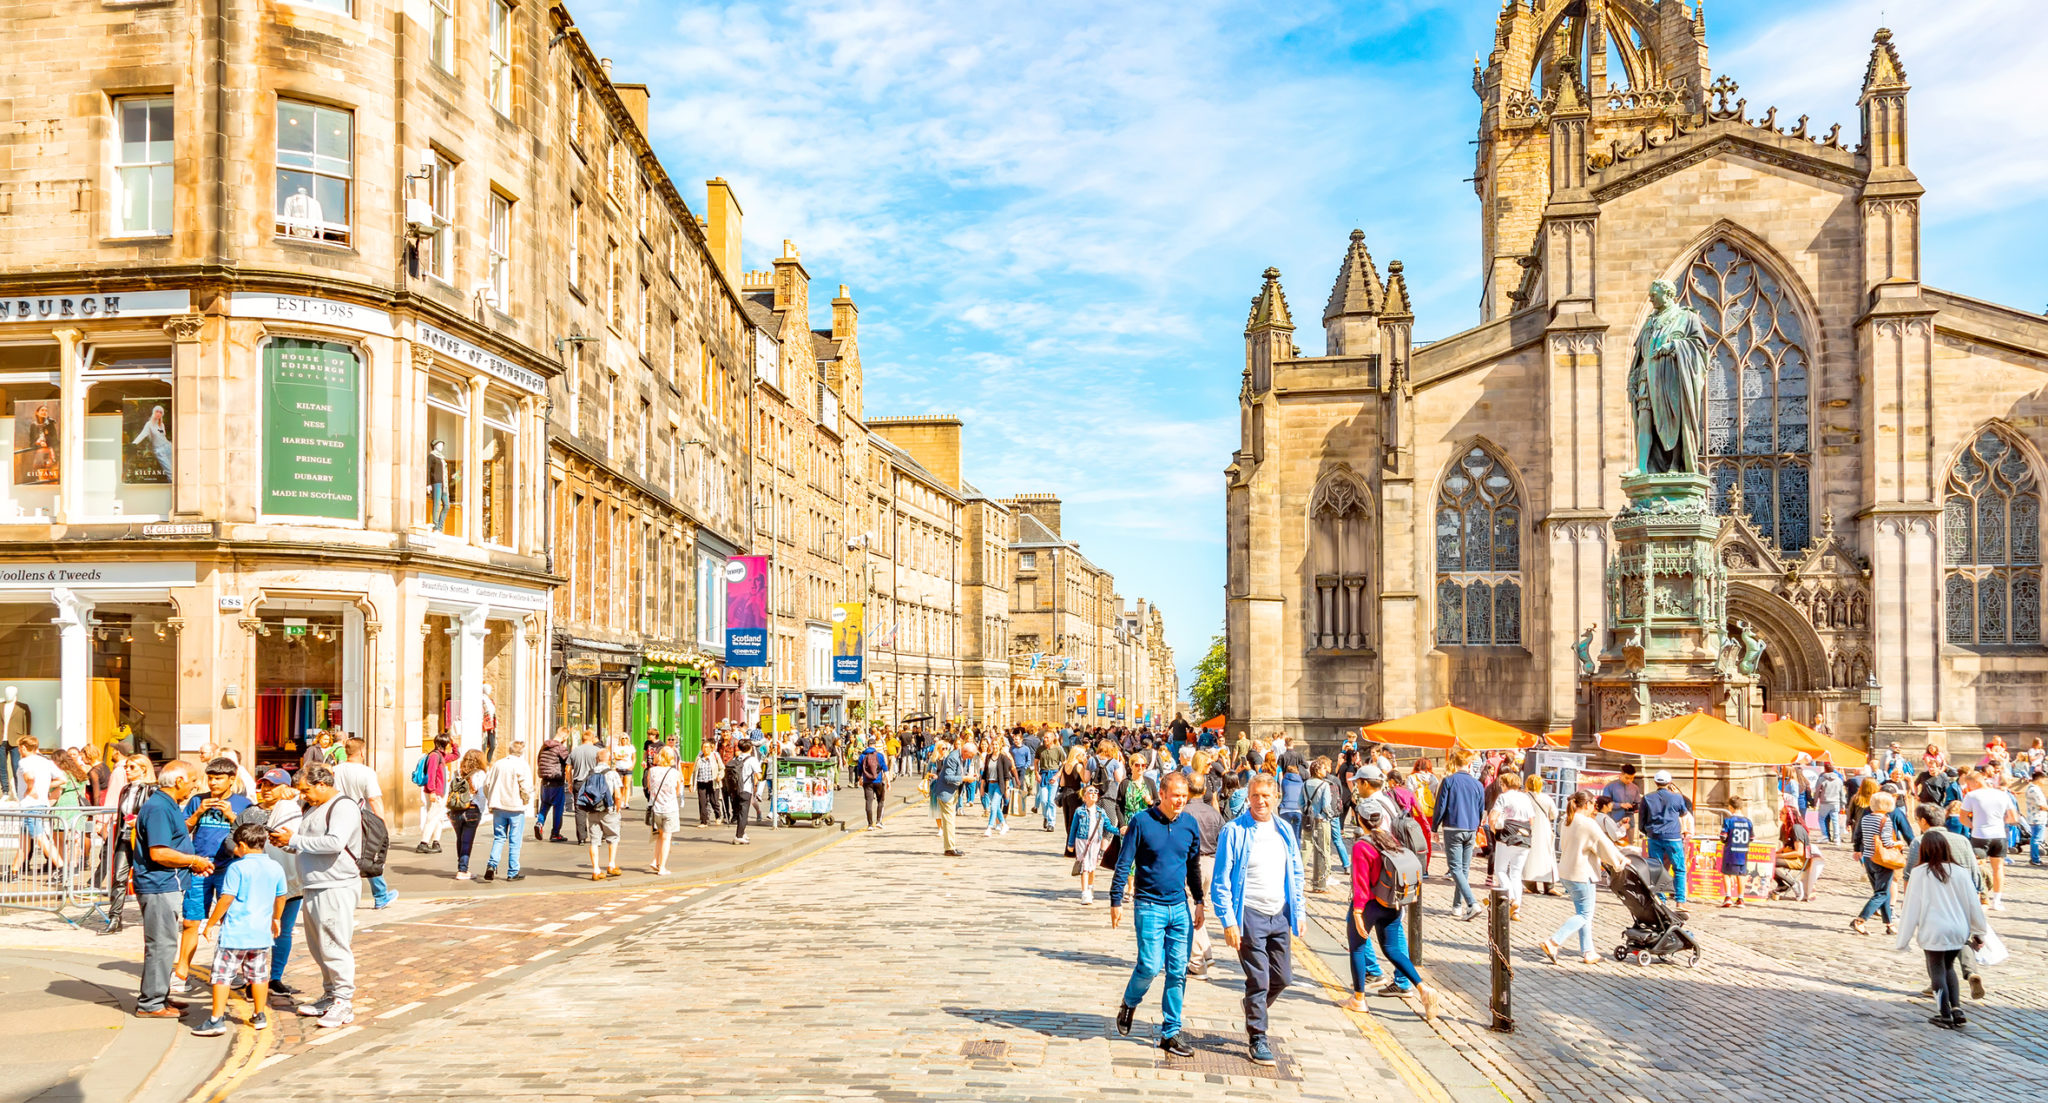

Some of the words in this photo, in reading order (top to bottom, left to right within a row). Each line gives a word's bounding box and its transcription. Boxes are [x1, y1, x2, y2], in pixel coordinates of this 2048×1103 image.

[322, 303, 354, 319] 1985
[281, 353, 319, 363] HOUSE
[422, 328, 460, 355] HOUSE
[468, 349, 482, 363] OF
[490, 358, 544, 391] EDINBURGH
[281, 362, 345, 375] EDINBURGH
[296, 402, 333, 412] KILTANE
[303, 420, 326, 429] NESS
[282, 437, 315, 445] HARRIS
[316, 439, 344, 448] TWEED
[296, 455, 332, 464] PRINGLE
[294, 472, 334, 482] DUBARRY
[310, 491, 353, 501] SCOTLAND
[156, 525, 177, 534] GILES
[182, 524, 210, 534] STREET
[48, 570, 55, 580] &
[59, 569, 101, 581] Tweeds
[221, 598, 242, 607] CSS
[731, 634, 762, 642] Scotland
[1732, 828, 1750, 844] 30
